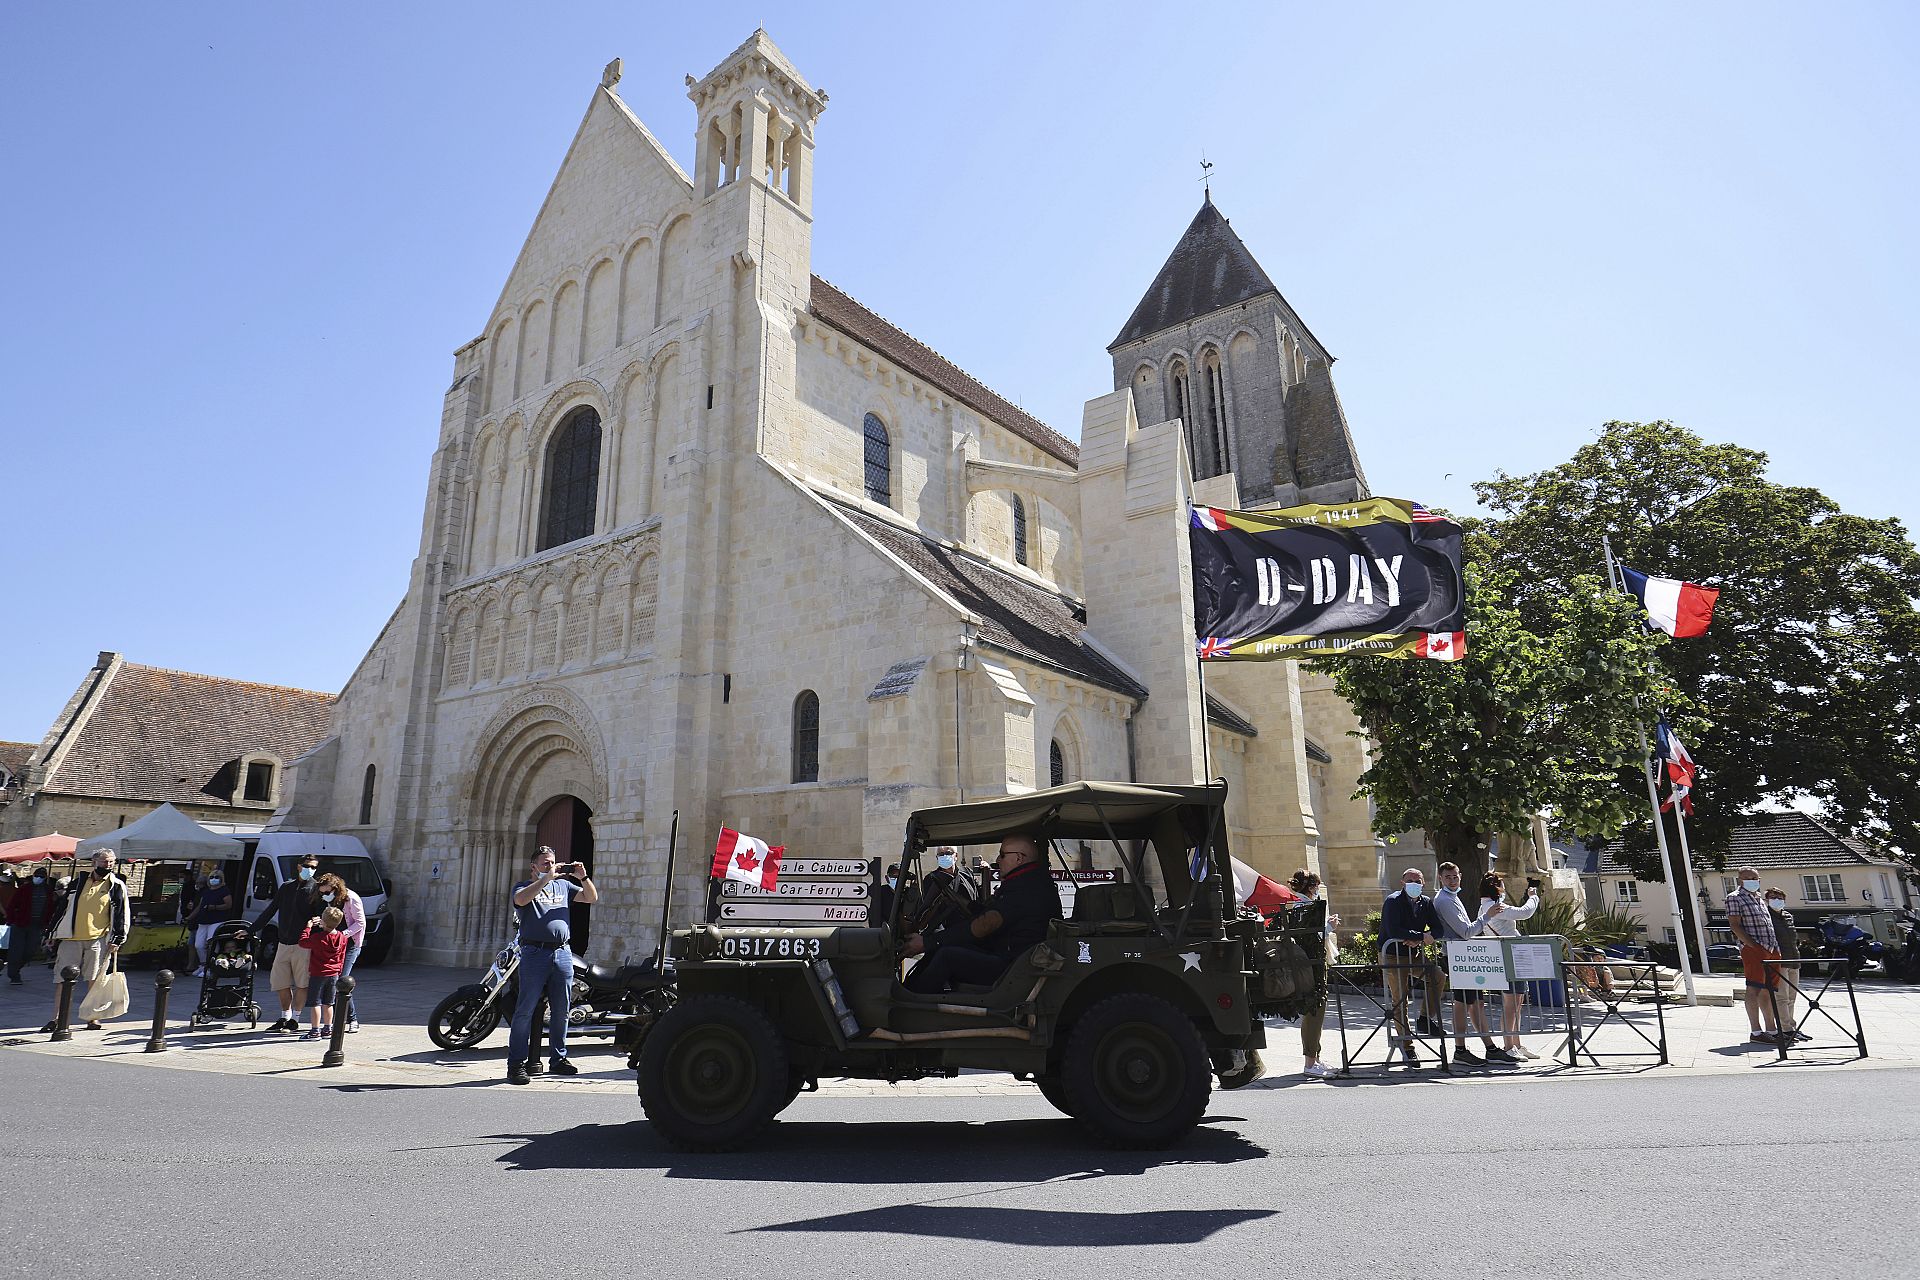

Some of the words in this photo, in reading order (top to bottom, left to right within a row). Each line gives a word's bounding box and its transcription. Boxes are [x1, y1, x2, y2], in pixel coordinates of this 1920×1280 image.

[1324, 507, 1359, 524] 1944
[1255, 553, 1403, 607] D-DAY
[794, 862, 804, 873] le
[811, 862, 851, 873] Cabieu
[780, 884, 844, 898] Car-Ferry
[823, 907, 867, 919] Mairie
[717, 938, 820, 956] 0517863
[1466, 945, 1488, 953] PORT
[1452, 965, 1504, 973] OBLIGATOIRE
